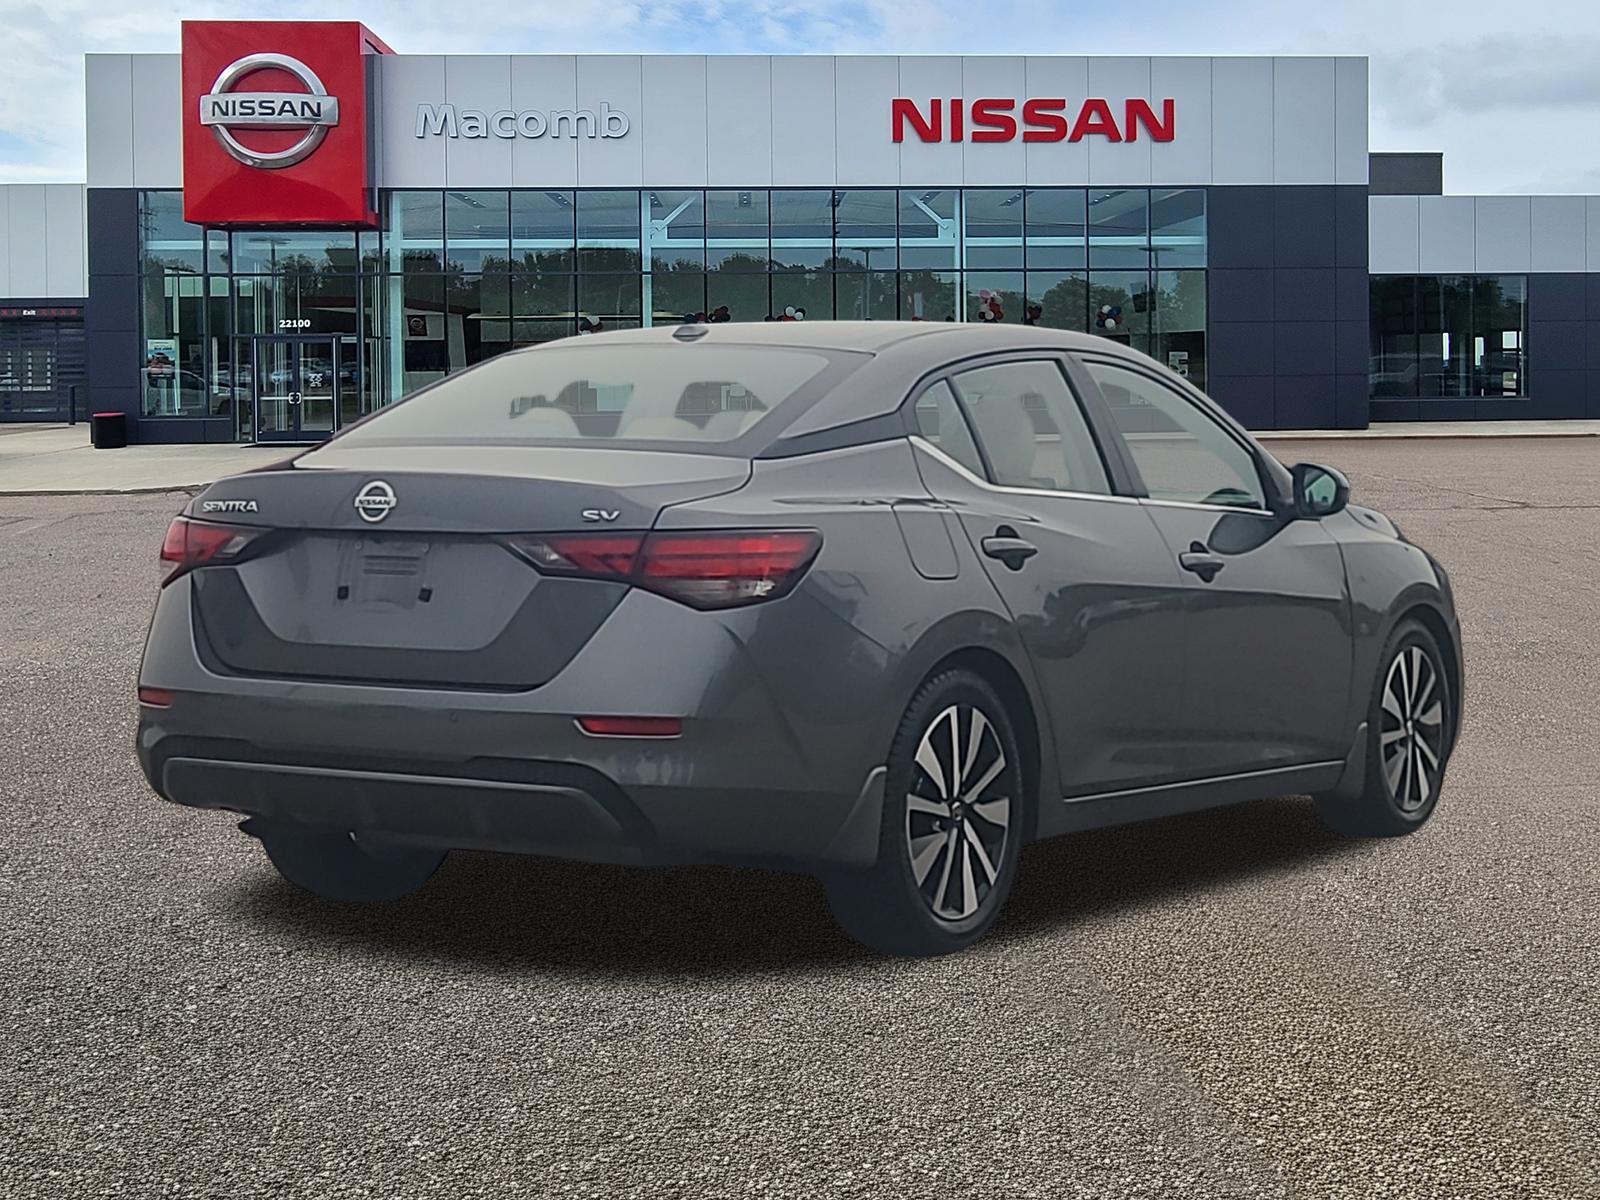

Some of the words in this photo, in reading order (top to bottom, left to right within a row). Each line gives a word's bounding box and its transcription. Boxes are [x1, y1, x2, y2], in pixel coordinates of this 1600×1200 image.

[211, 100, 322, 118] NISSAN
[415, 102, 630, 139] Macomb
[892, 98, 1175, 143] NISSAN
[279, 319, 311, 328] 22100
[202, 500, 258, 512] SENTRA
[582, 510, 620, 521] SV
